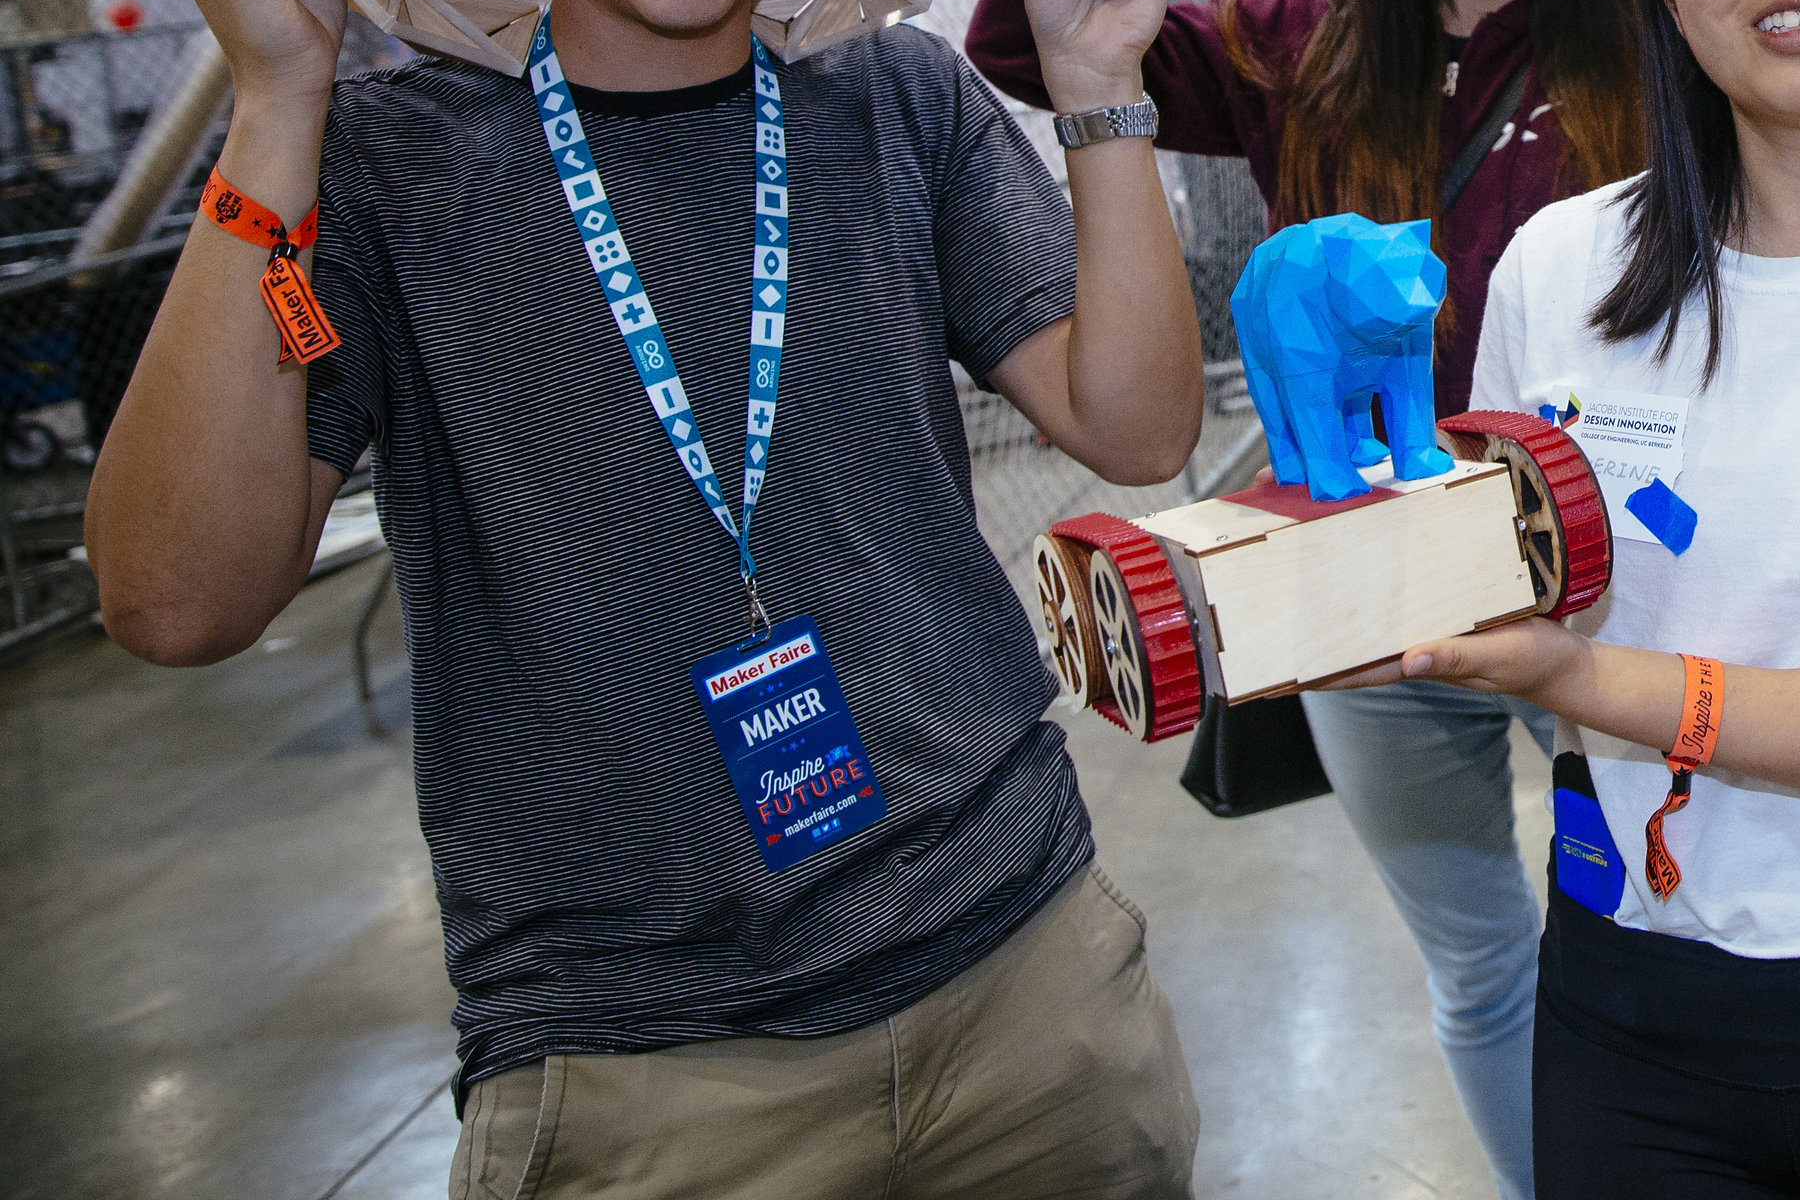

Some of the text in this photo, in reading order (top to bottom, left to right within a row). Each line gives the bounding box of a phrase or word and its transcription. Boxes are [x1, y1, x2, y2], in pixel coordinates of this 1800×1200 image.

[283, 289, 322, 350] Maker
[1584, 415, 1676, 435] DESIGN INNOVATION
[1587, 403, 1679, 422] JACOBS INSTITUTE FOR
[1581, 432, 1599, 440] COLLEGE
[1648, 441, 1673, 450] BERKELEY
[1591, 458, 1661, 484] ERINE
[710, 641, 811, 696] Maker Faire
[739, 687, 826, 747] MAKER
[1681, 690, 1717, 755] Inspire
[756, 756, 825, 804] Inspire
[756, 758, 865, 825] FUTURE
[784, 793, 857, 838] makerfaire.com
